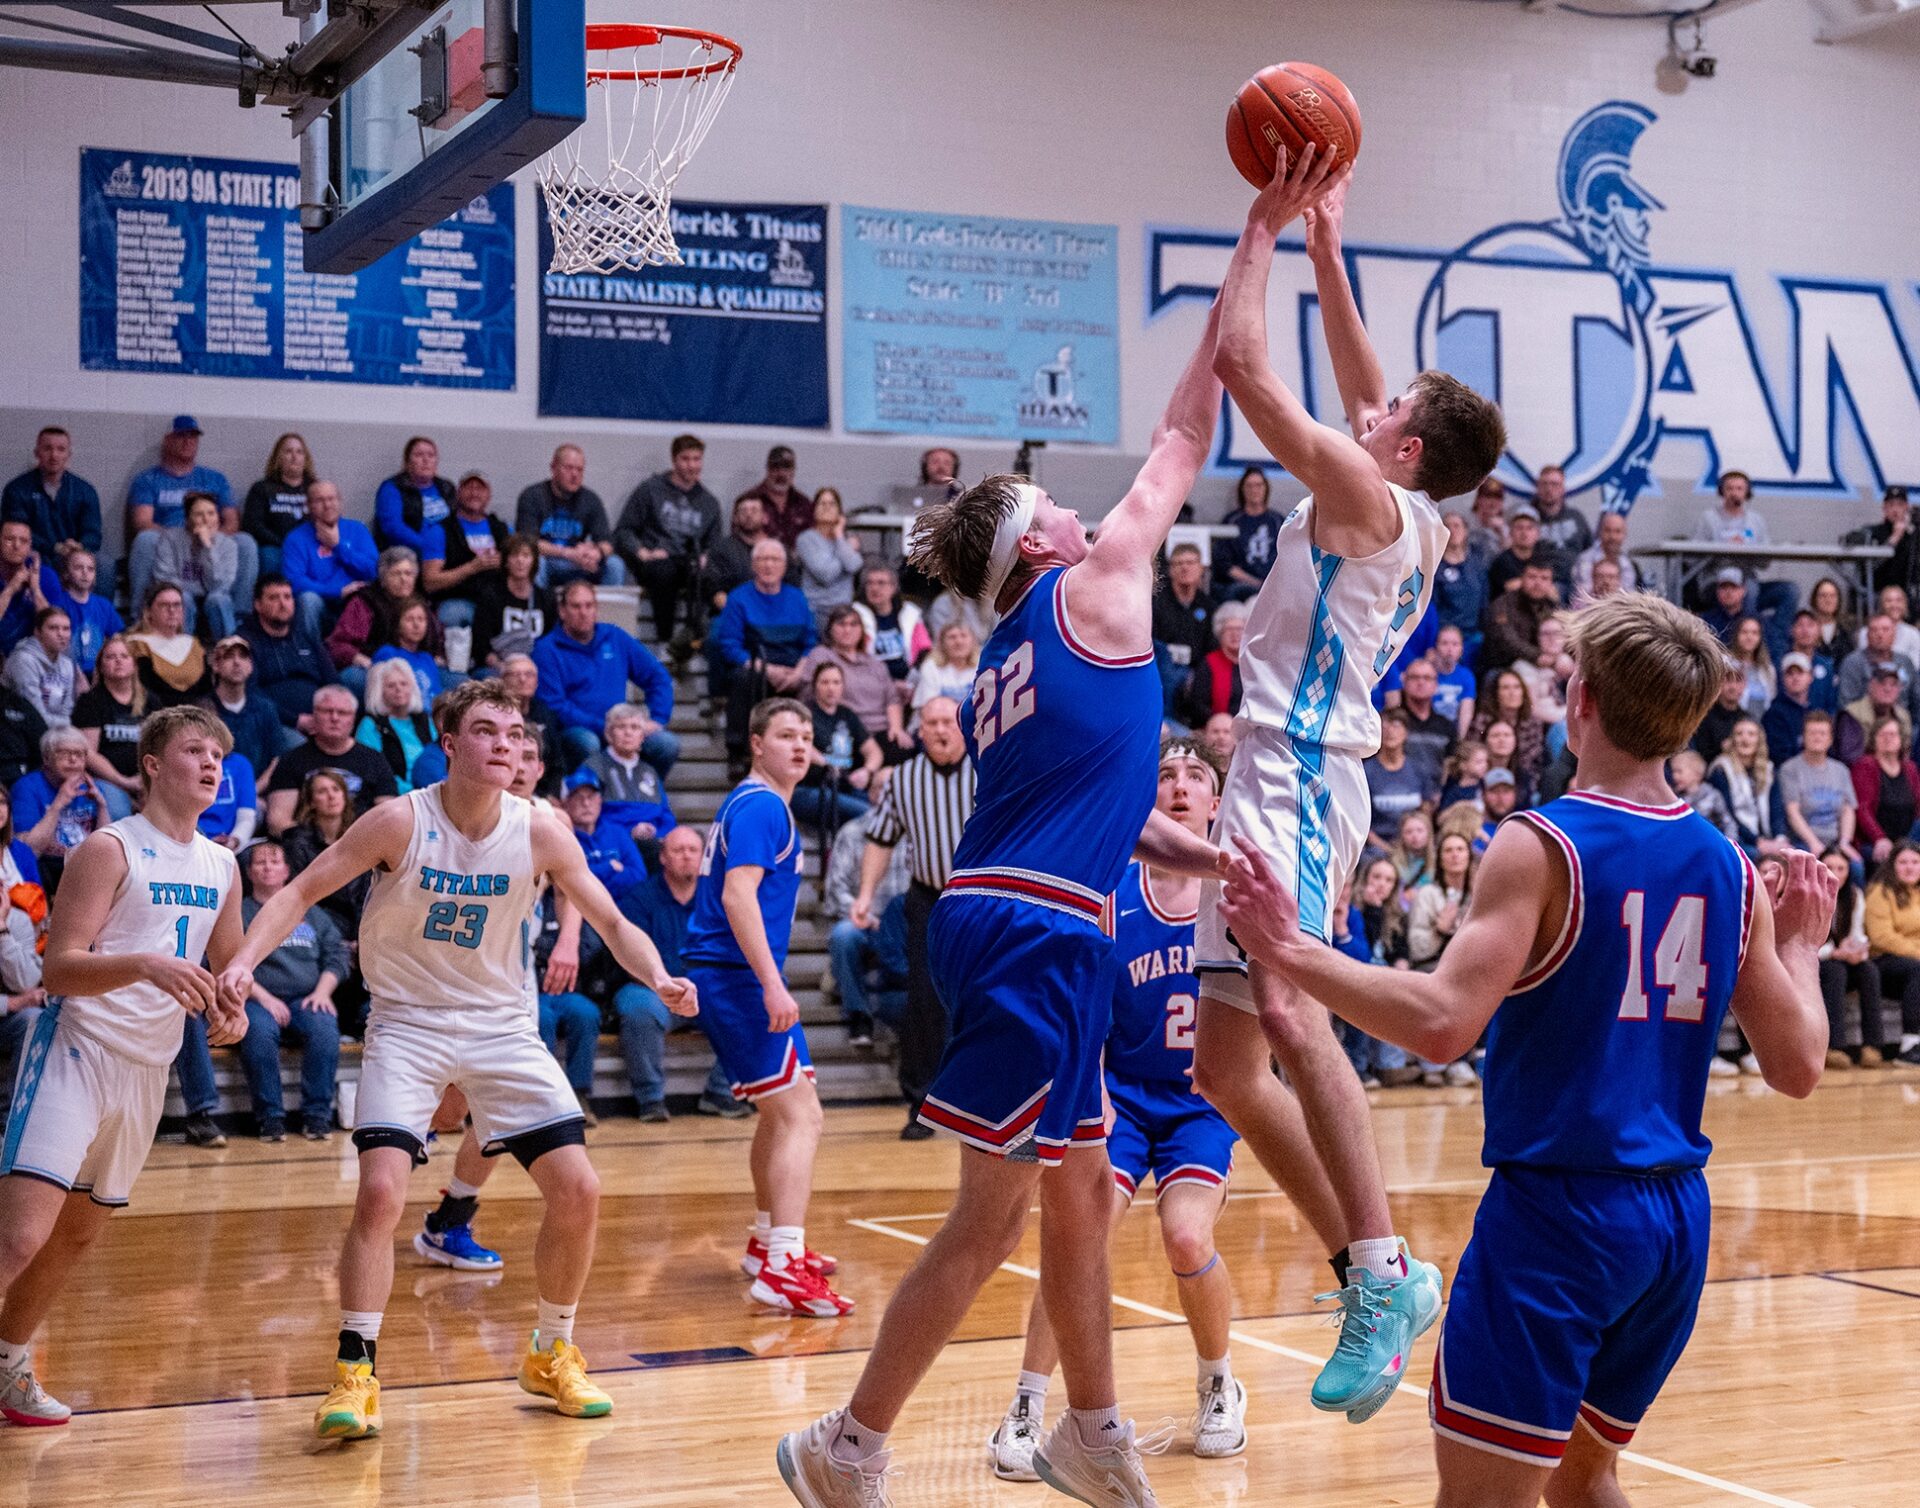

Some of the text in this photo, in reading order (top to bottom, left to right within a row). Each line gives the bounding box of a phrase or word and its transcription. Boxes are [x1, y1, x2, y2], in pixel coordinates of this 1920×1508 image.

[141, 165, 188, 203] 2013
[191, 168, 217, 204] 9A
[219, 171, 273, 208] STATE
[745, 213, 822, 243] Titans
[544, 274, 824, 314] STATE FINALISTS & QUALIFIERS
[1146, 232, 1920, 492] TITAN
[971, 640, 1037, 762] 22
[149, 882, 219, 911] TITANS
[420, 866, 510, 897] TITANS
[175, 915, 189, 960] 1
[423, 901, 489, 950] 23
[1617, 889, 1710, 1025] 14
